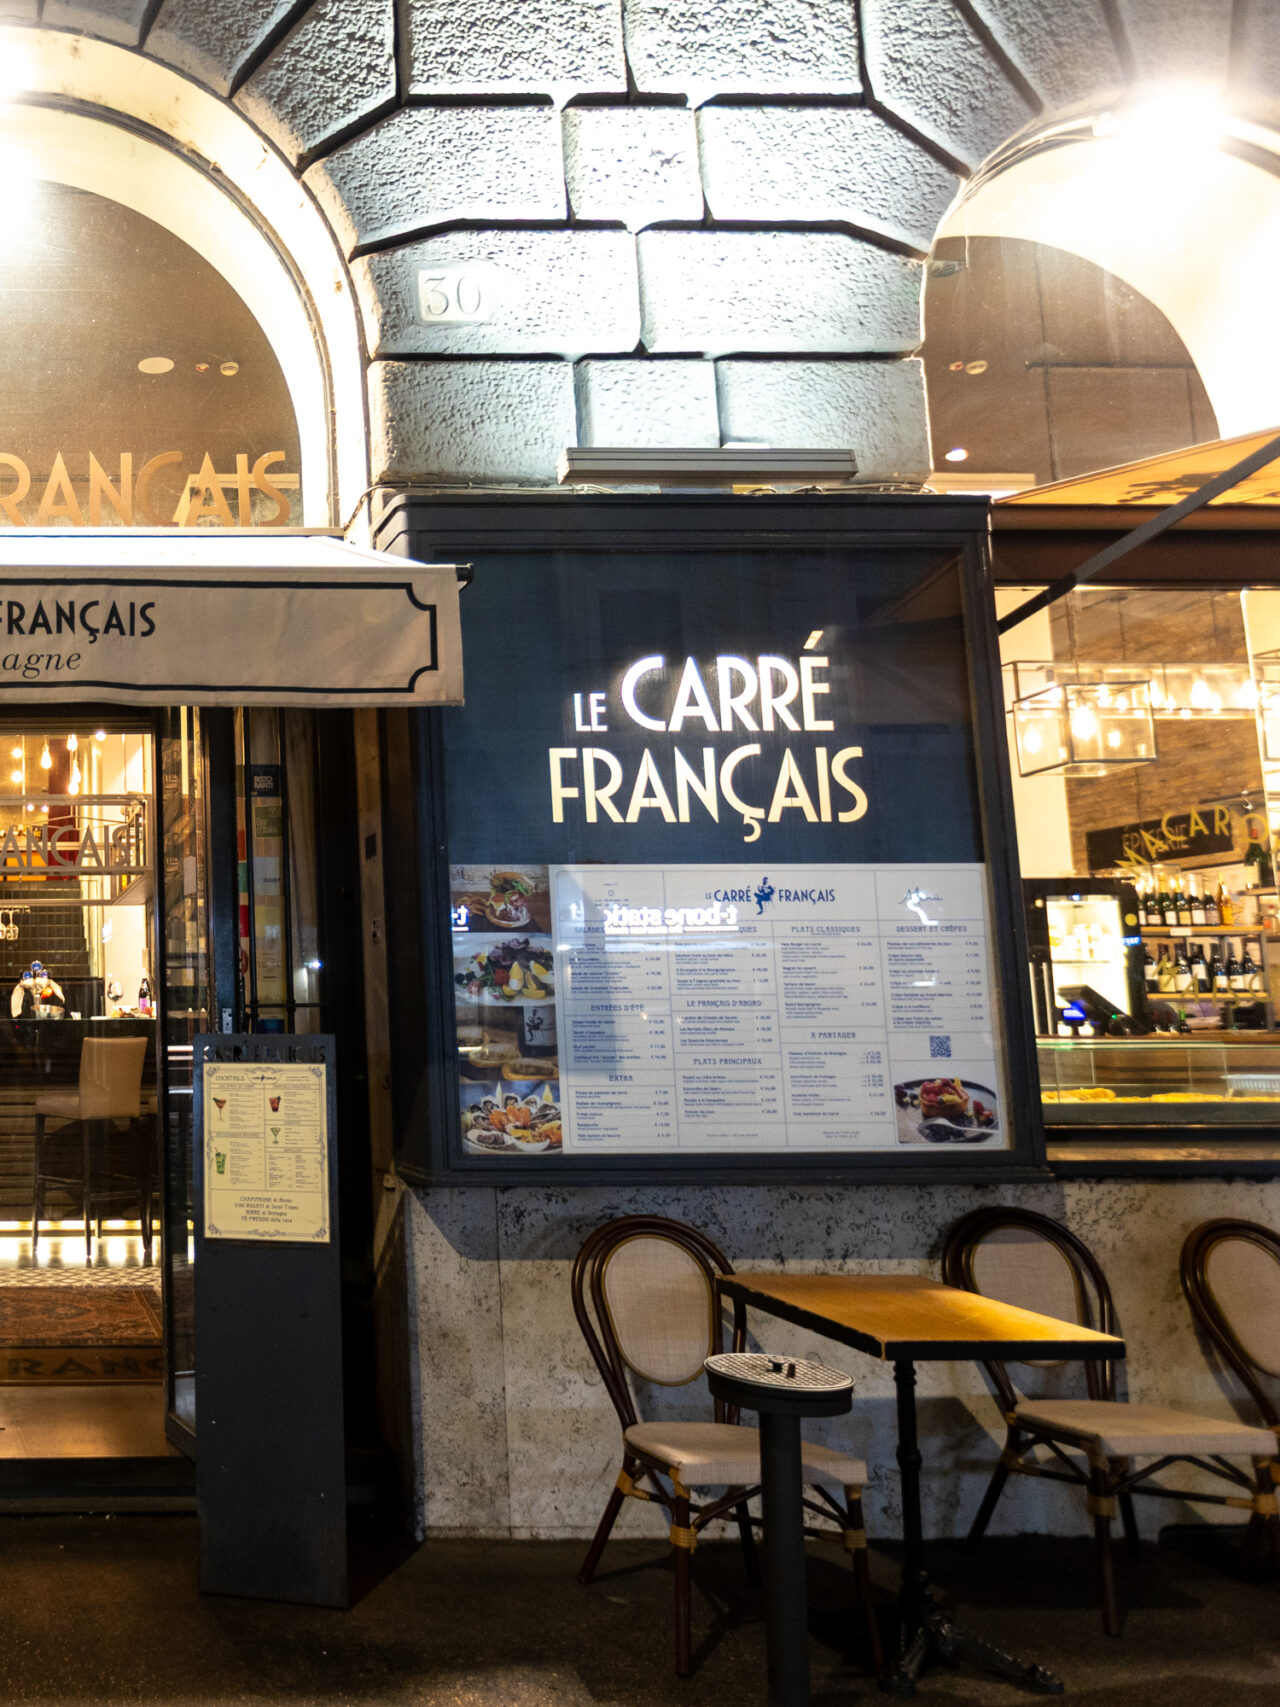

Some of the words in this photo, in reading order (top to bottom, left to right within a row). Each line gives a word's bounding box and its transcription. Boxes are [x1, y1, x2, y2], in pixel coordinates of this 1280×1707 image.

[424, 275, 482, 315] 30
[573, 692, 608, 732] LE
[620, 630, 835, 733] CARRÉ
[548, 743, 869, 844] FRANÇAIS
[714, 884, 751, 903] CARRÉ
[778, 888, 836, 906] FRANÇAIS
